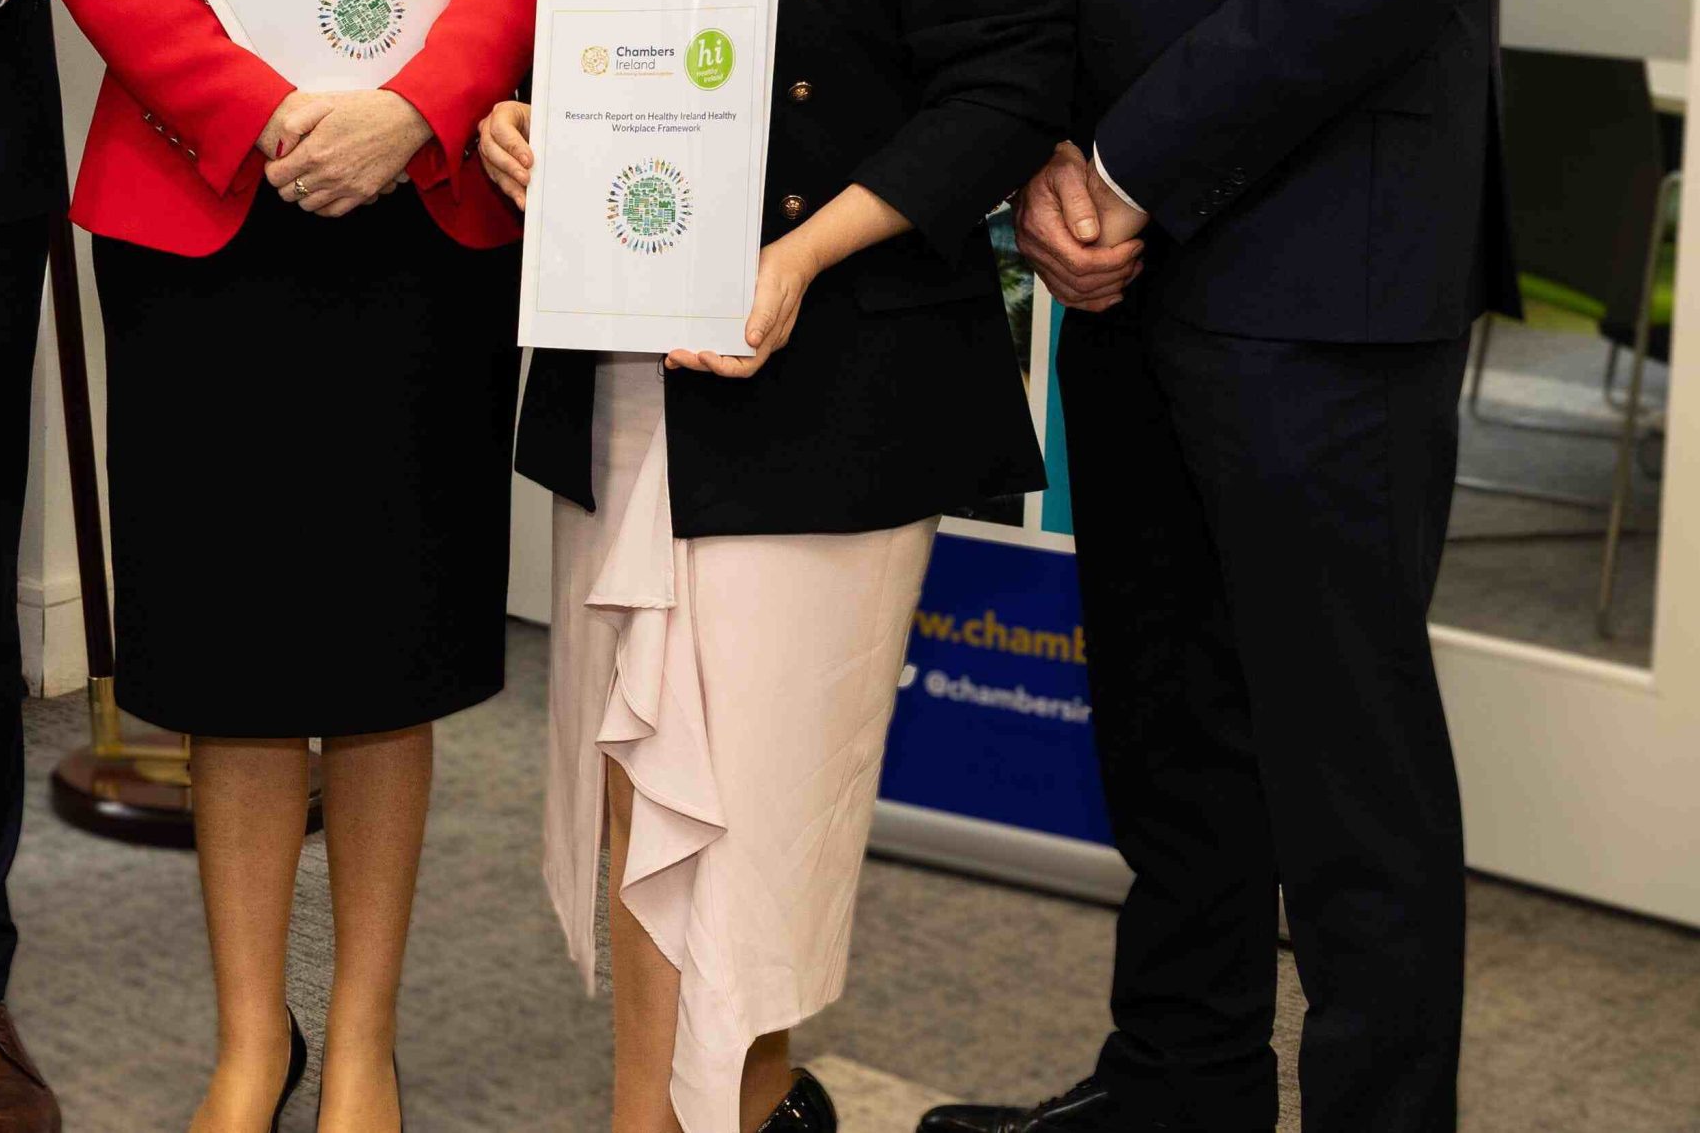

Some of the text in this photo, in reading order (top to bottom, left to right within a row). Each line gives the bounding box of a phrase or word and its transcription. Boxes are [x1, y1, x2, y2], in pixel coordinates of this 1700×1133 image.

[616, 45, 675, 57] Chambers
[697, 38, 724, 68] hi
[615, 59, 656, 70] Ireland
[565, 111, 603, 120] Research
[605, 111, 633, 122] Report
[647, 111, 678, 122] Healthy
[680, 111, 706, 120] Ireland
[708, 111, 737, 122] Healthy
[612, 123, 701, 133] Workplace Framework
